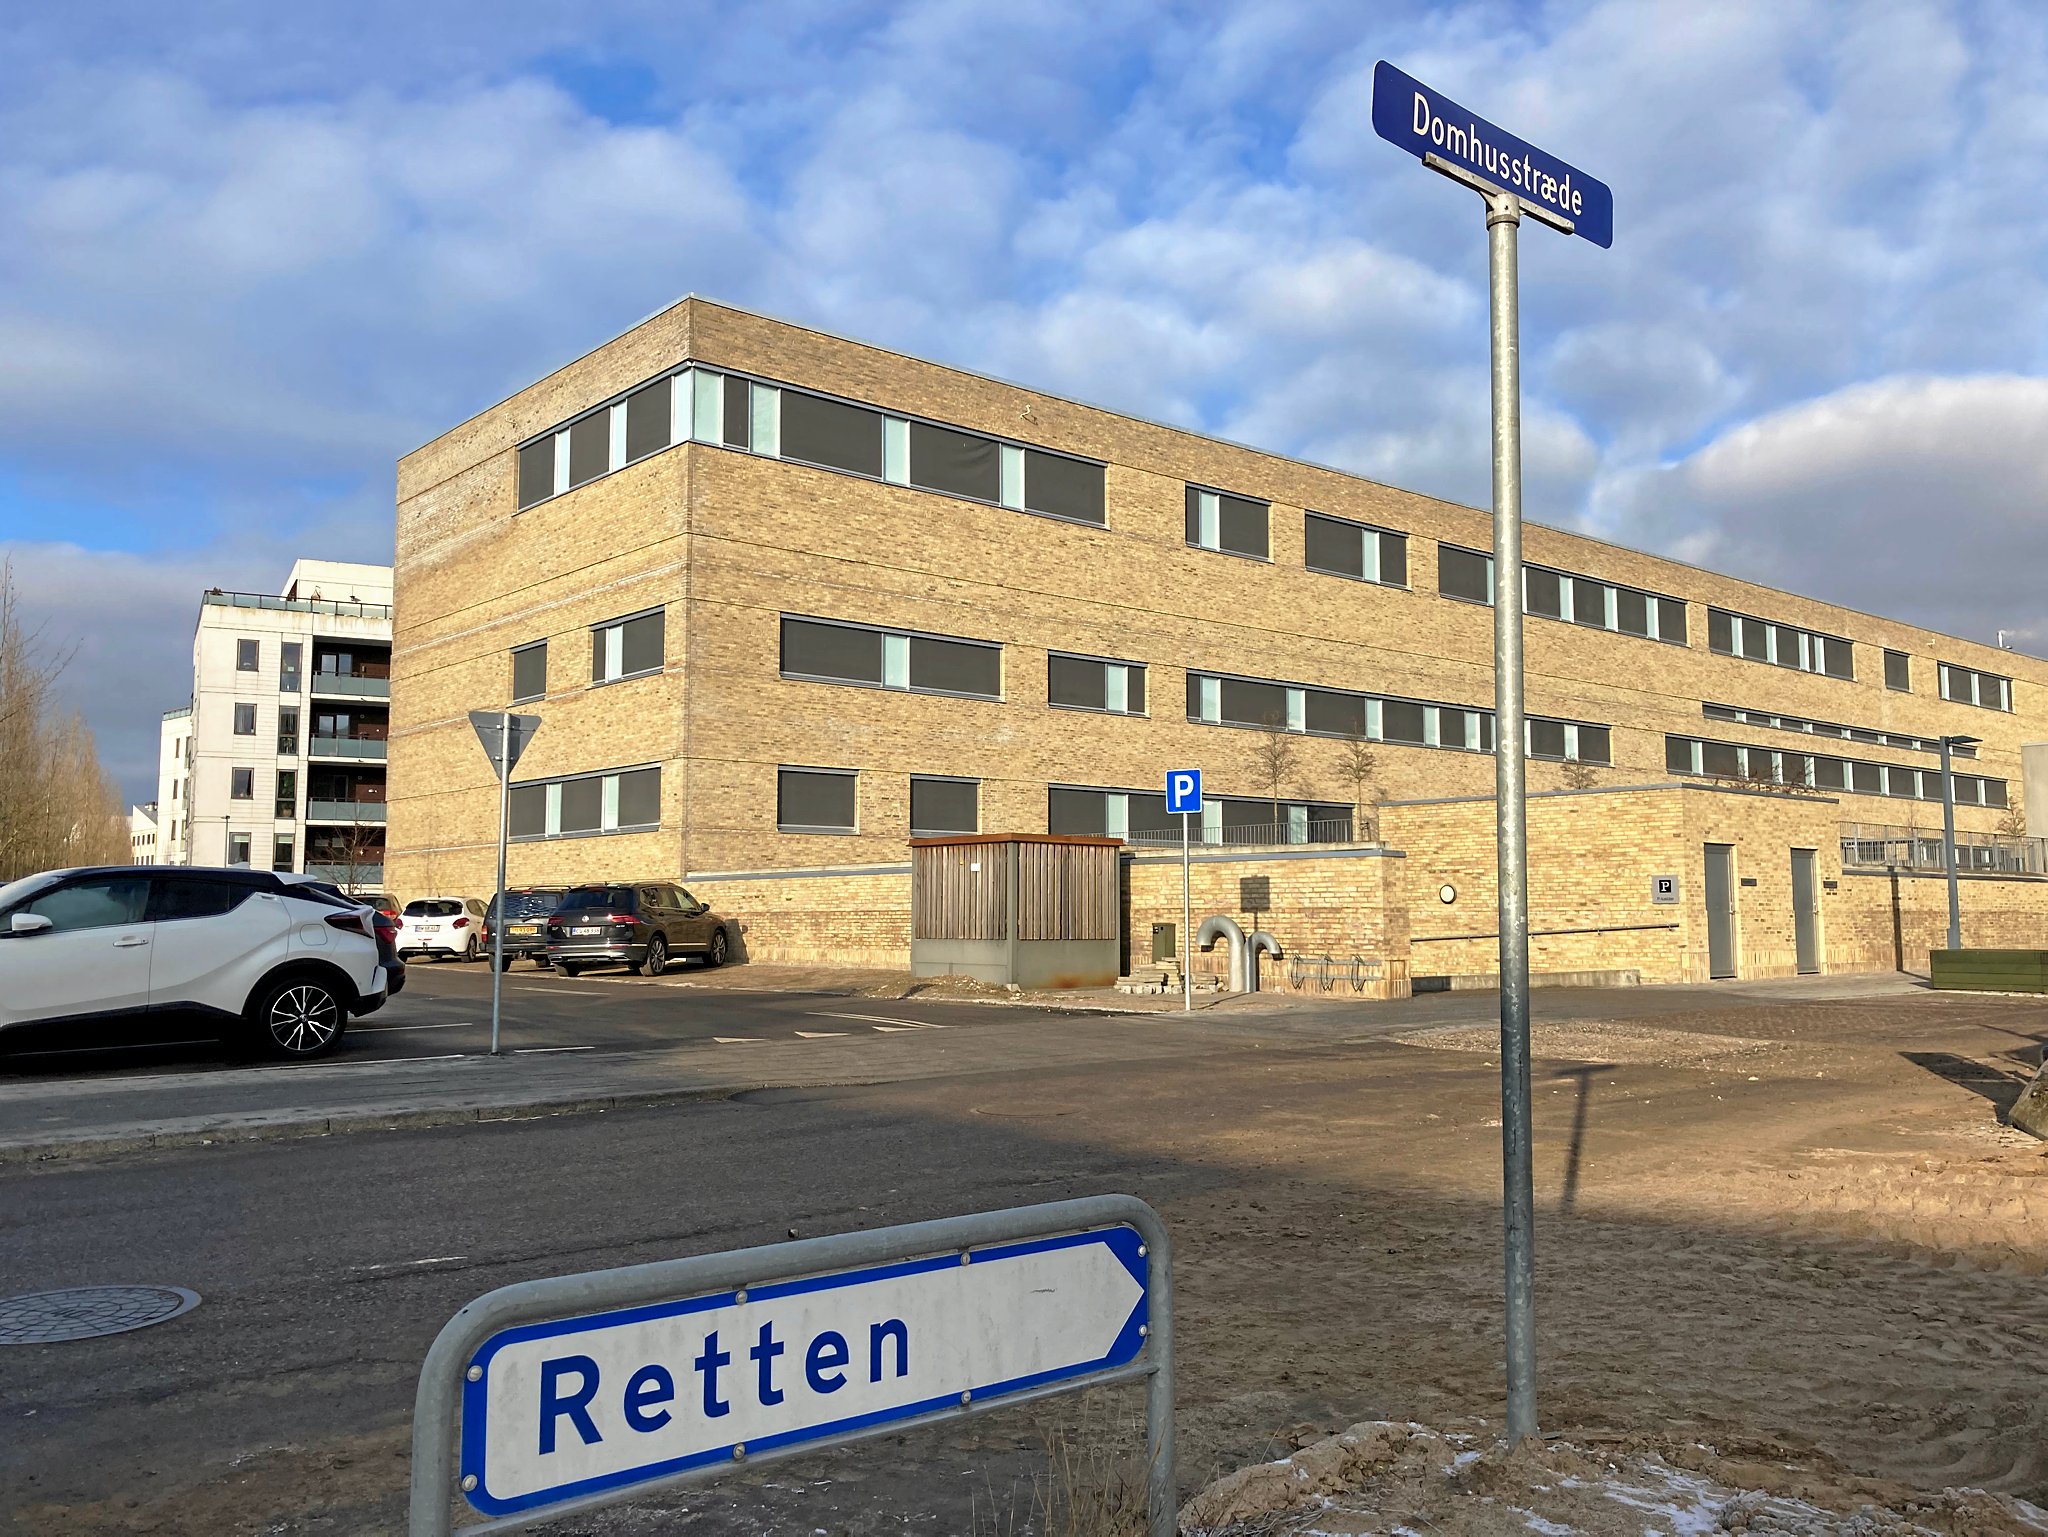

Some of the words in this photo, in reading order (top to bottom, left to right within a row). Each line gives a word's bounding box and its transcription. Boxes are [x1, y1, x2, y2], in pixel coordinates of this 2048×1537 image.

[1412, 91, 1583, 217] Domhusstræde
[1174, 774, 1194, 808] P
[1660, 881, 1670, 892] P
[537, 1318, 910, 1456] Retten
